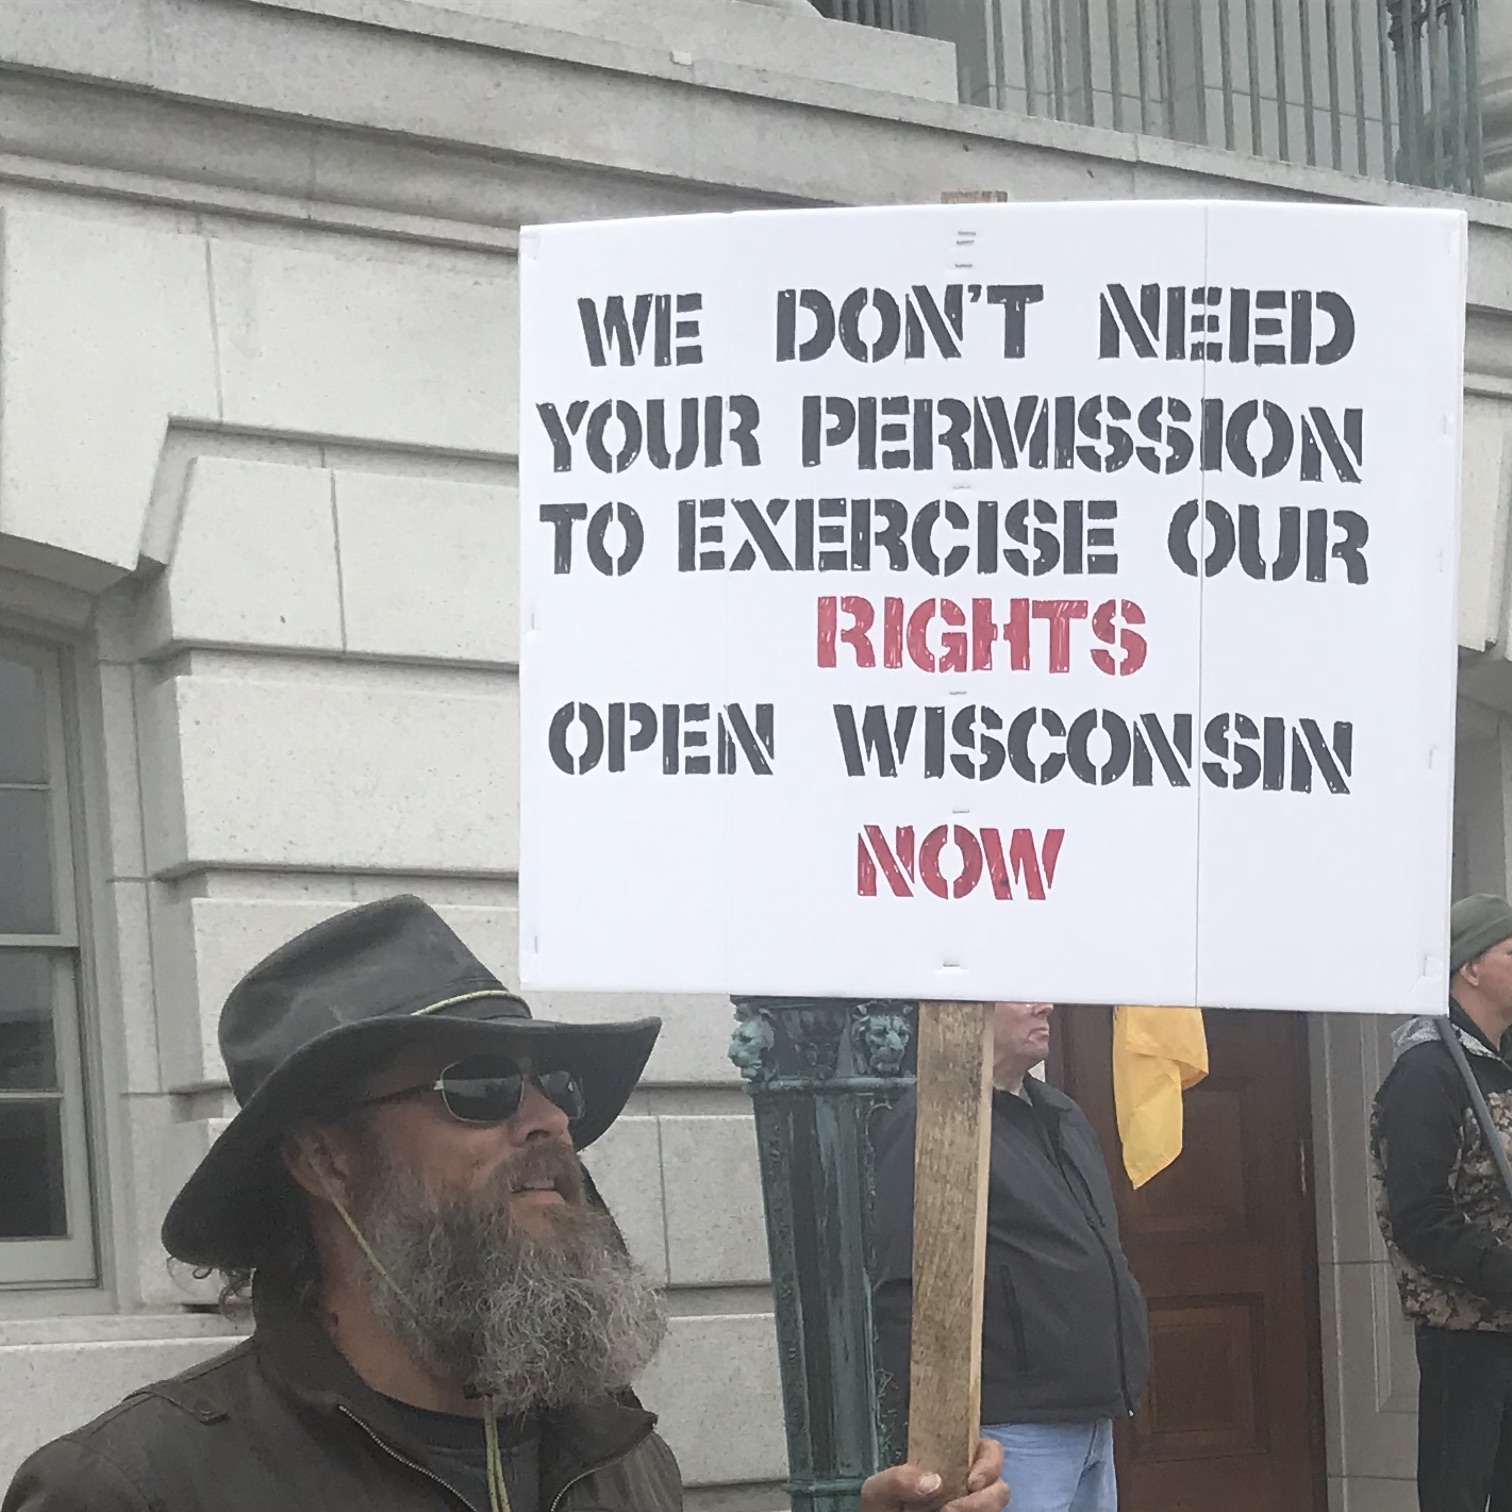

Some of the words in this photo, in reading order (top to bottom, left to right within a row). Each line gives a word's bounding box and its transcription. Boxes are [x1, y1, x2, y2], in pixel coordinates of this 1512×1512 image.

[577, 292, 704, 368] WE
[776, 284, 1044, 365] DON'T
[1099, 283, 1356, 366] NEED
[535, 394, 763, 475] YOUR
[801, 396, 1364, 483] PERMISSION
[538, 502, 644, 577] TO
[678, 498, 1119, 577] EXERCISE
[1168, 499, 1370, 585] OUR
[816, 596, 1149, 677] RIGHTS
[547, 702, 774, 776] OPEN
[832, 705, 1353, 795] WISCONSIN
[857, 824, 1066, 901] NOW
